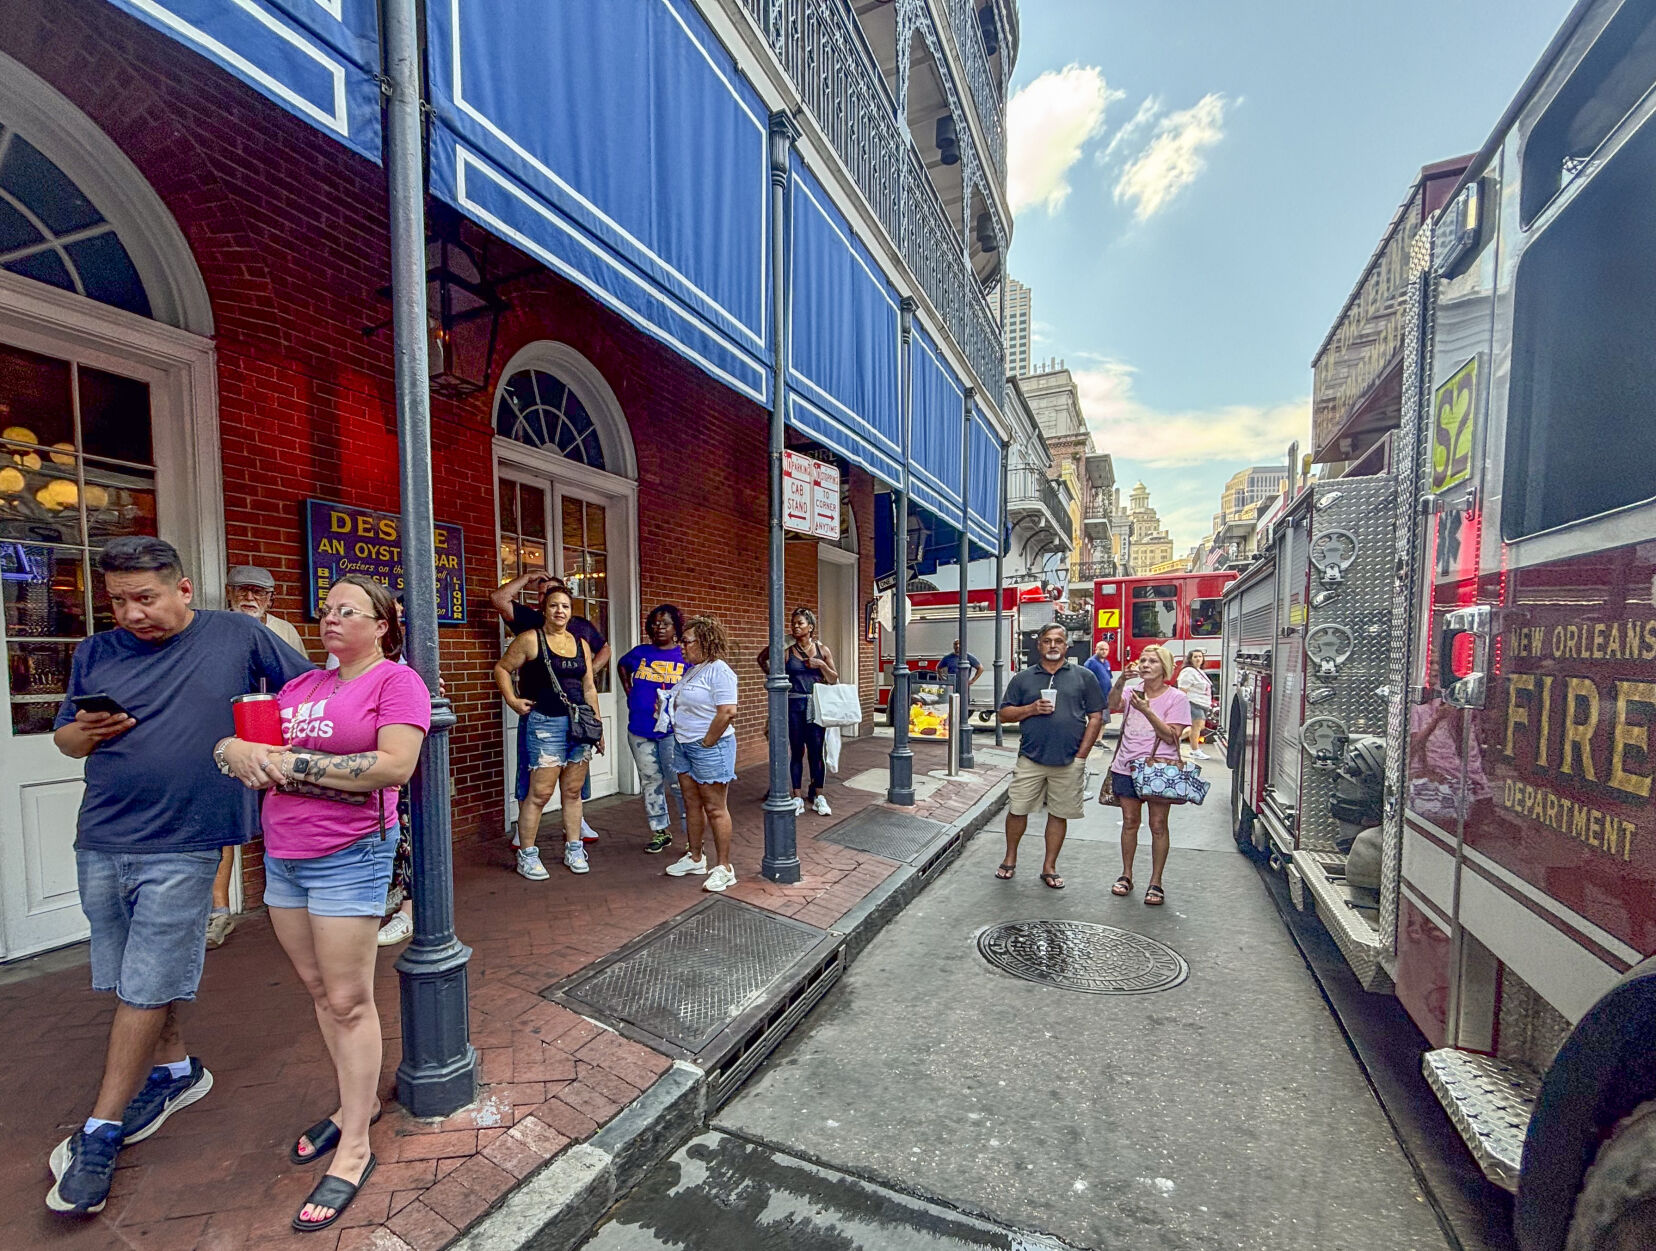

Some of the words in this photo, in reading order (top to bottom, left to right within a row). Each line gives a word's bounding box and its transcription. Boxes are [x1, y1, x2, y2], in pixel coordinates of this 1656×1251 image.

[1433, 371, 1474, 489] S2
[791, 482, 803, 496] CAB
[823, 491, 829, 499] TO
[788, 498, 807, 513] STAND
[816, 500, 836, 511] CORNER
[330, 511, 448, 548] DESE
[816, 522, 838, 533] ANYTIME
[318, 538, 344, 556] AN
[339, 558, 374, 573] Oysters
[378, 565, 390, 573] on
[452, 576, 463, 619] LIQUOR
[1102, 609, 1116, 627] 7
[1510, 624, 1545, 657] NEW
[1552, 618, 1656, 660] ORLEANS
[638, 657, 685, 676] LSU
[282, 718, 334, 738] didas
[1503, 673, 1656, 798] FIRE
[1504, 778, 1637, 862] DEPARTMENT
